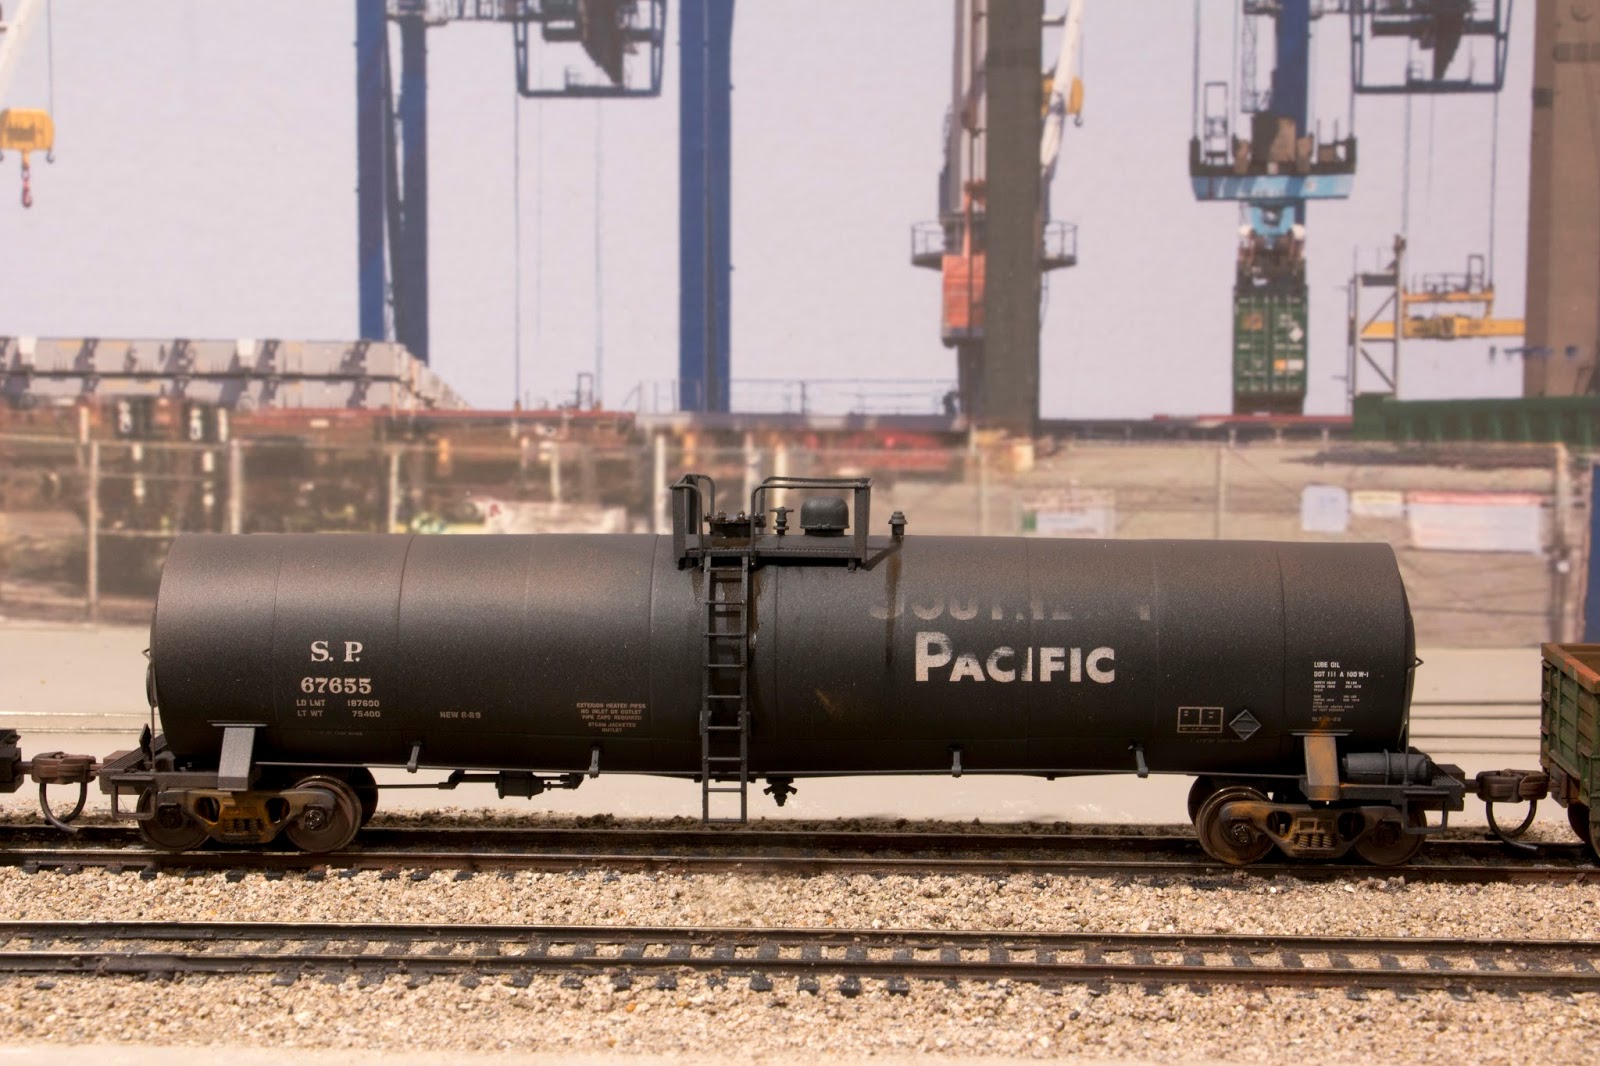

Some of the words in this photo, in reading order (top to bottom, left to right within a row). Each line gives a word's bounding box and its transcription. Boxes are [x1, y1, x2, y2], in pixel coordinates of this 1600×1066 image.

[310, 640, 334, 662] S.
[343, 641, 363, 663] P.
[915, 631, 1115, 684] PACIFIC
[300, 677, 372, 694] 67655
[296, 699, 307, 707] LD
[309, 699, 326, 707] LMT
[347, 699, 380, 707] 187600
[351, 710, 381, 718] 75400
[440, 711, 459, 719] NEW
